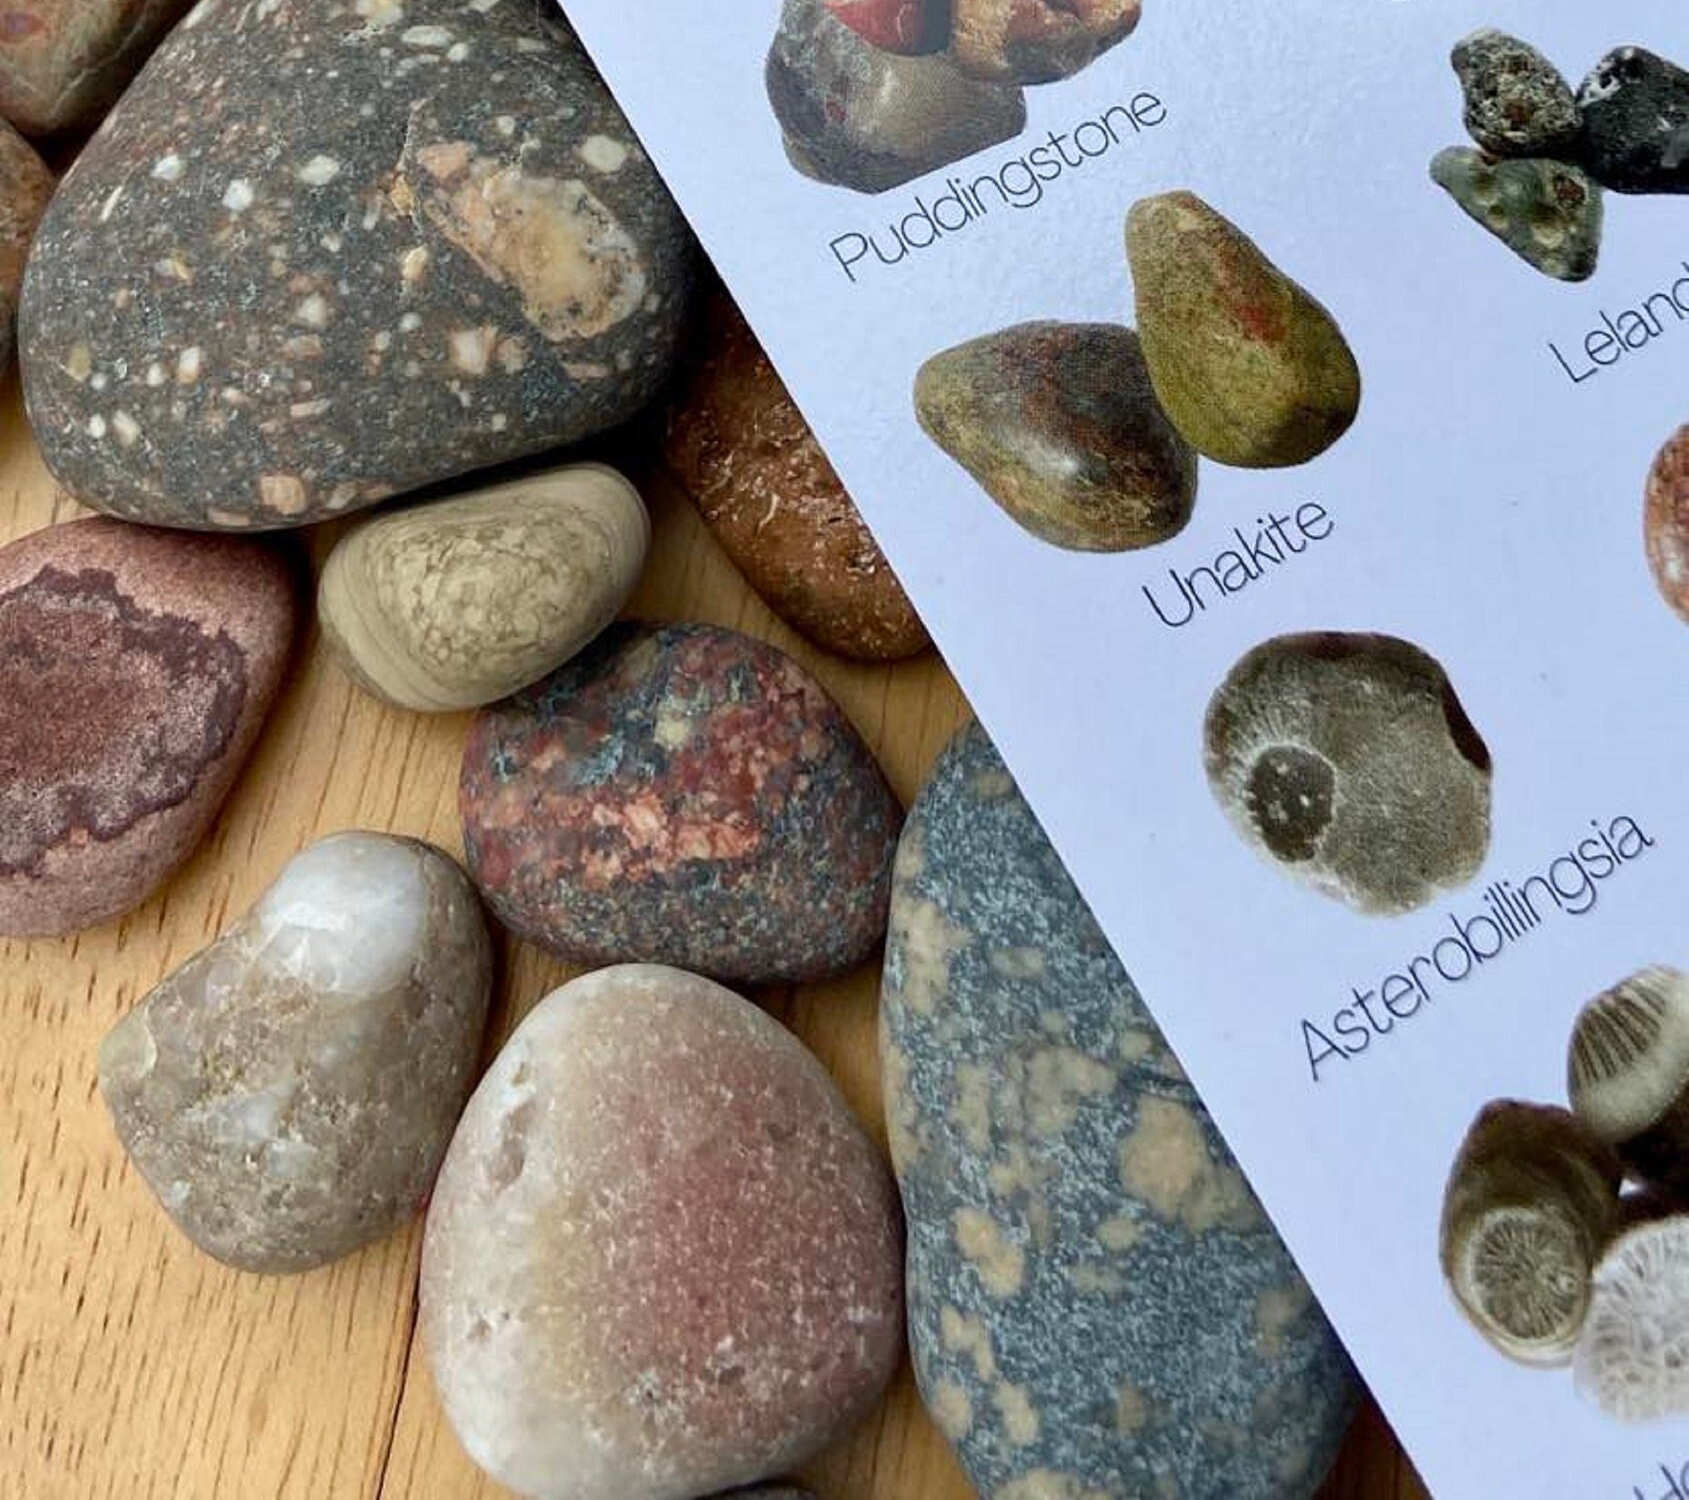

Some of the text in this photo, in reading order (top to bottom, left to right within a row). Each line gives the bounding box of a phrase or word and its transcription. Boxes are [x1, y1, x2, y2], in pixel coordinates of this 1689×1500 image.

[829, 90, 1168, 282] Puddingstone
[1142, 501, 1335, 629] Unakite
[1299, 814, 1656, 1082] Asterobillingsia
